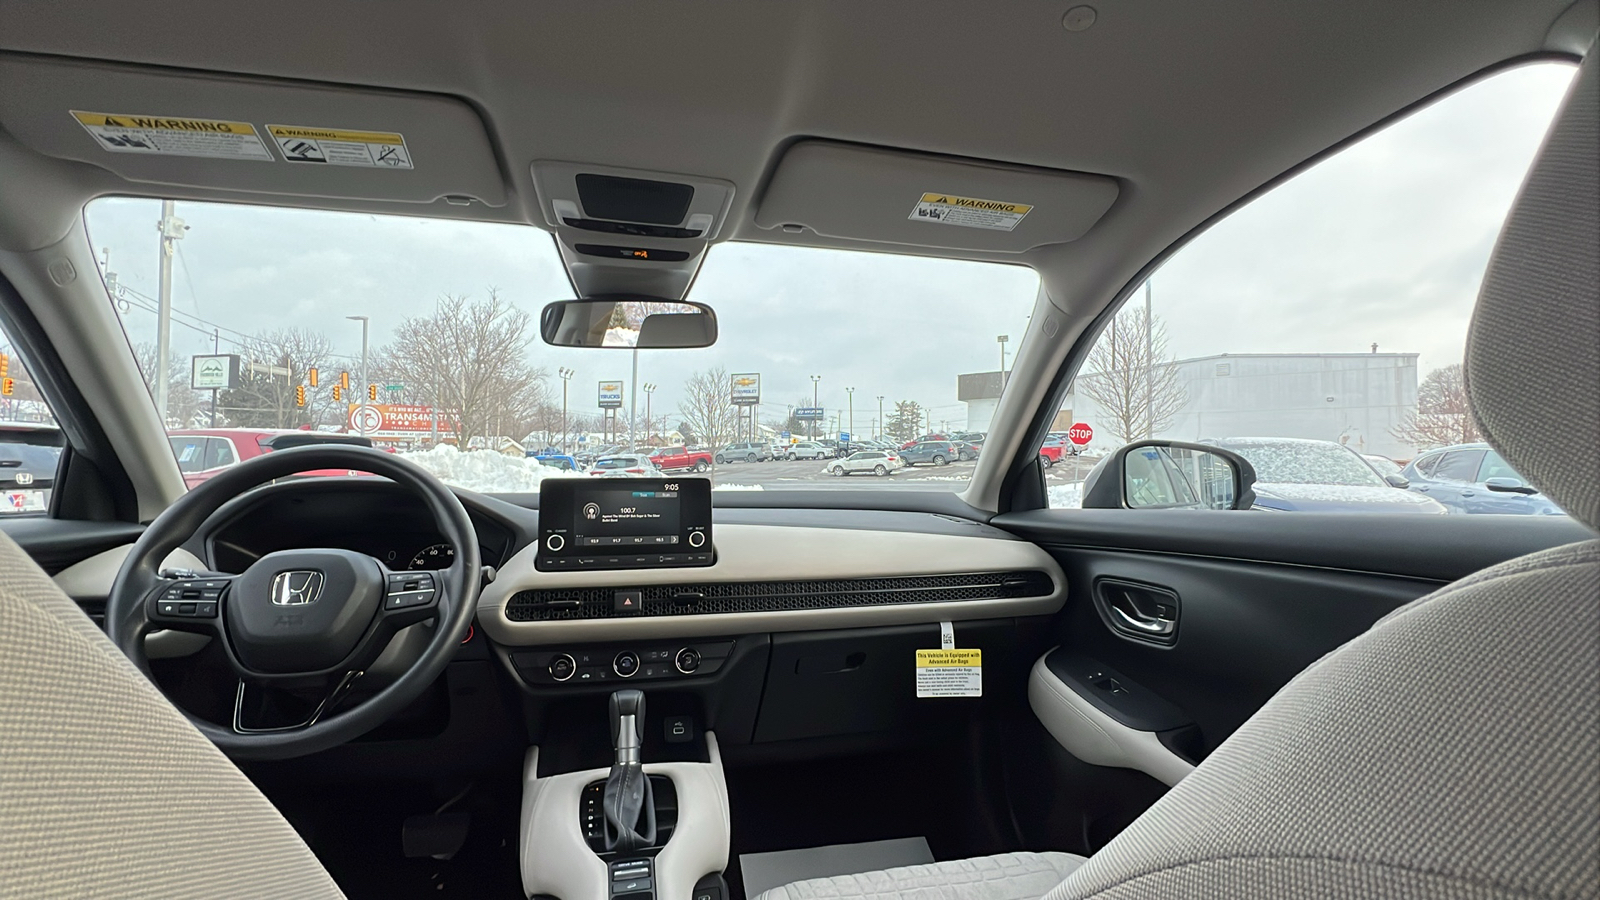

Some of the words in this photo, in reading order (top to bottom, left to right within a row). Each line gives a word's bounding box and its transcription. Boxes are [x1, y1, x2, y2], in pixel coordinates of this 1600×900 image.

[131, 118, 232, 133] WARNING
[285, 129, 337, 138] WARNING
[955, 198, 1015, 212] WARNING
[1070, 428, 1092, 439] STOP
[664, 483, 679, 491] 9:05
